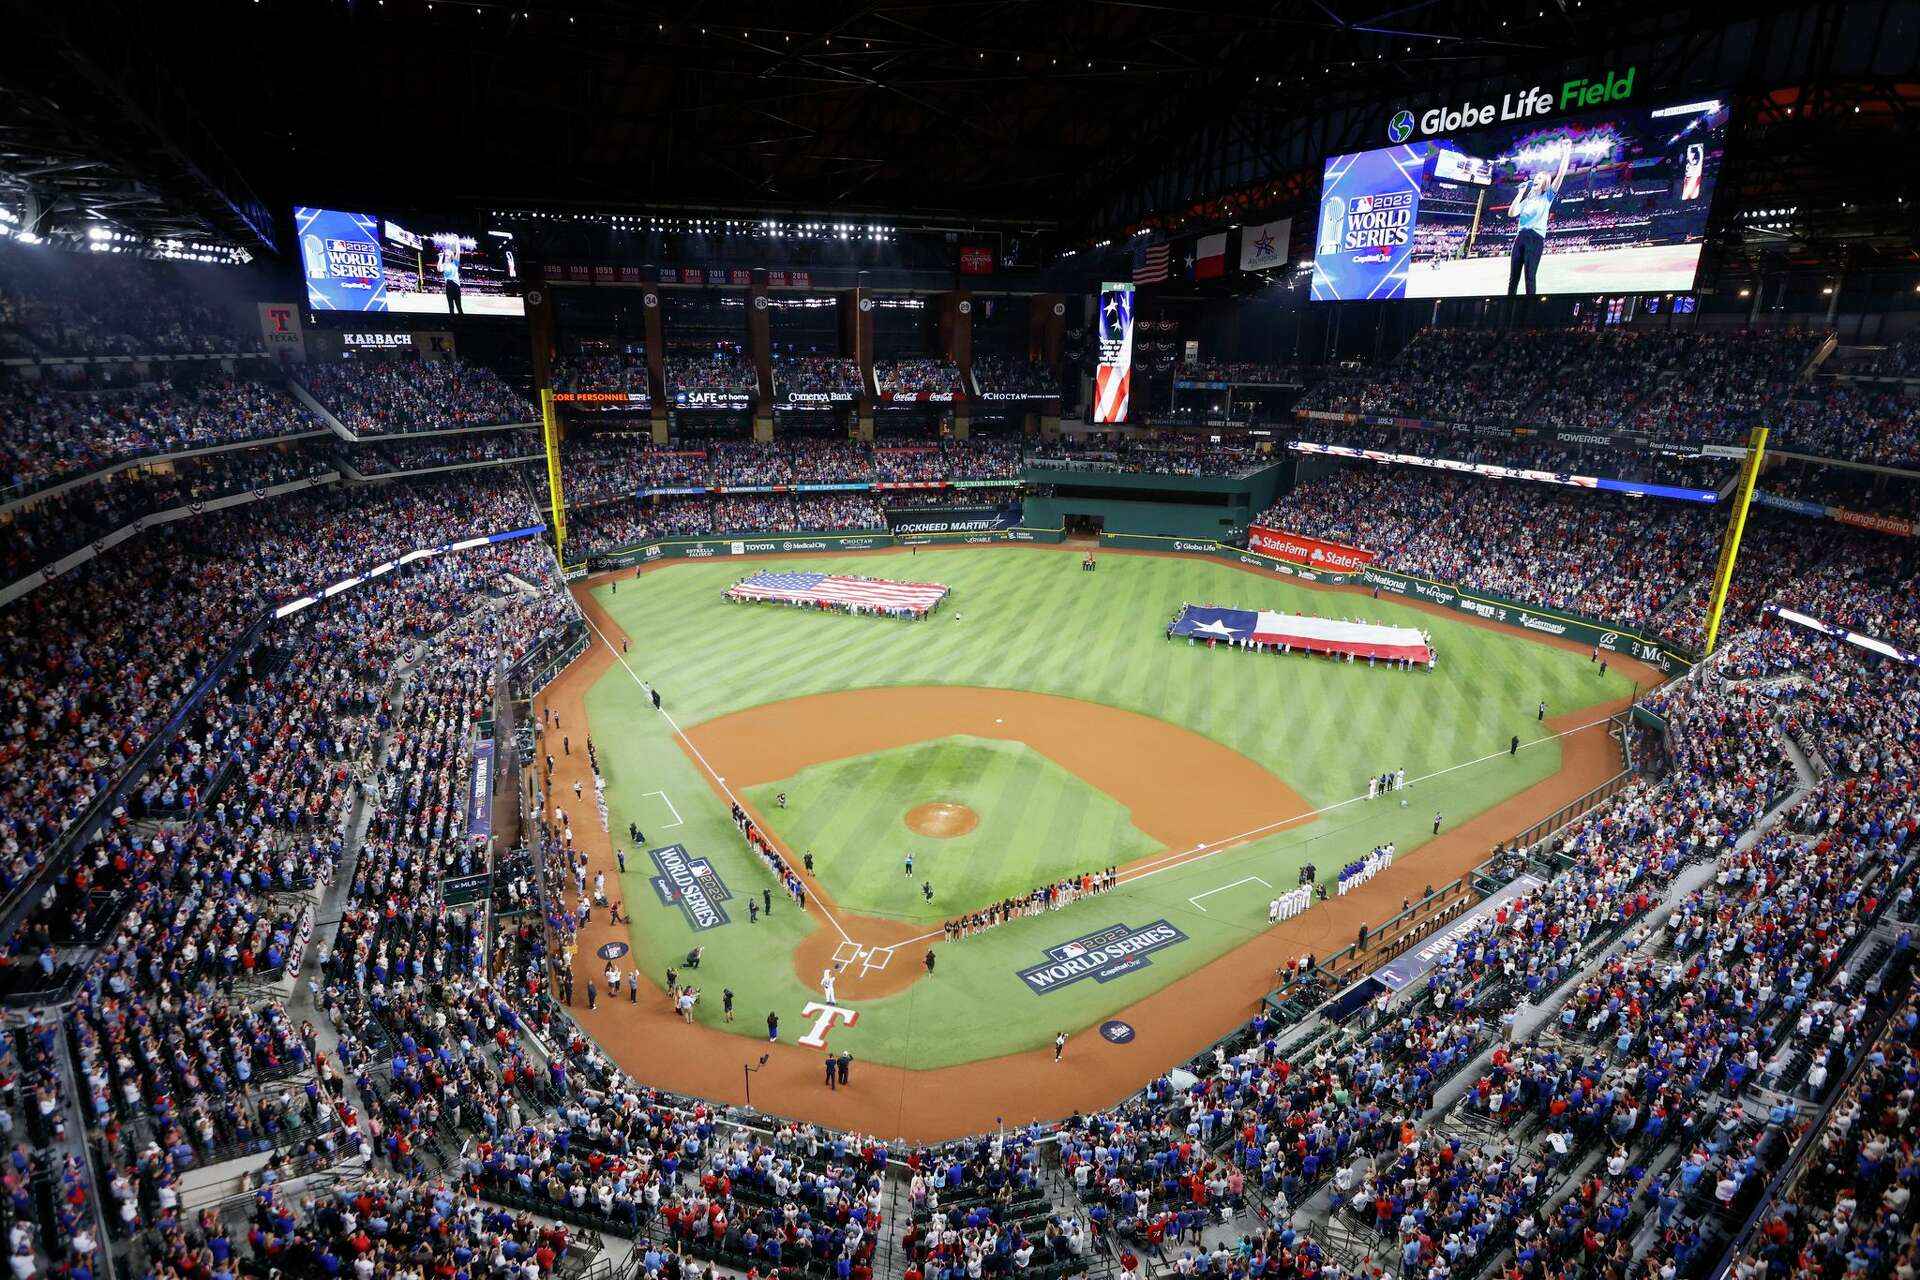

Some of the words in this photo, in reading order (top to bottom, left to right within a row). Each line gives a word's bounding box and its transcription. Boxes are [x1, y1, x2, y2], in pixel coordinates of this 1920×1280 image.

[1420, 102, 1496, 135] Globe
[1501, 87, 1554, 121] Life
[1560, 67, 1635, 110] Field
[1374, 194, 1413, 208] 2023
[1348, 209, 1411, 231] WORLD
[1344, 226, 1410, 249] SERIES
[346, 243, 376, 252] 2023
[328, 251, 378, 267] WORLD
[330, 263, 380, 279] SERIES
[269, 333, 299, 342] TEXAS
[343, 333, 412, 345] KARBACH
[577, 393, 628, 401] PERSONNEL
[689, 393, 717, 403] SAFE
[831, 392, 852, 401] Bank
[987, 392, 1028, 400] CHOCTAW
[1452, 423, 1470, 432] PGL
[1557, 432, 1611, 445] POWERADE
[986, 479, 1020, 487] STAFFING
[895, 522, 948, 532] LOCKHEED
[951, 521, 989, 530] MARTIN
[1843, 511, 1909, 533] orange.promo
[646, 545, 661, 556] UTA
[745, 543, 776, 551] TOYOTA
[1204, 543, 1216, 551] Life
[1372, 573, 1407, 589] National
[1426, 585, 1455, 604] Kroger
[460, 880, 477, 888] MLB
[659, 847, 694, 887] WORLD
[680, 884, 719, 927] SERIES
[700, 875, 724, 900] 2023
[1082, 929, 1129, 948] 2023
[1026, 950, 1108, 986] WORLD
[1104, 925, 1176, 959] SERIES
[798, 1001, 860, 1050] T
